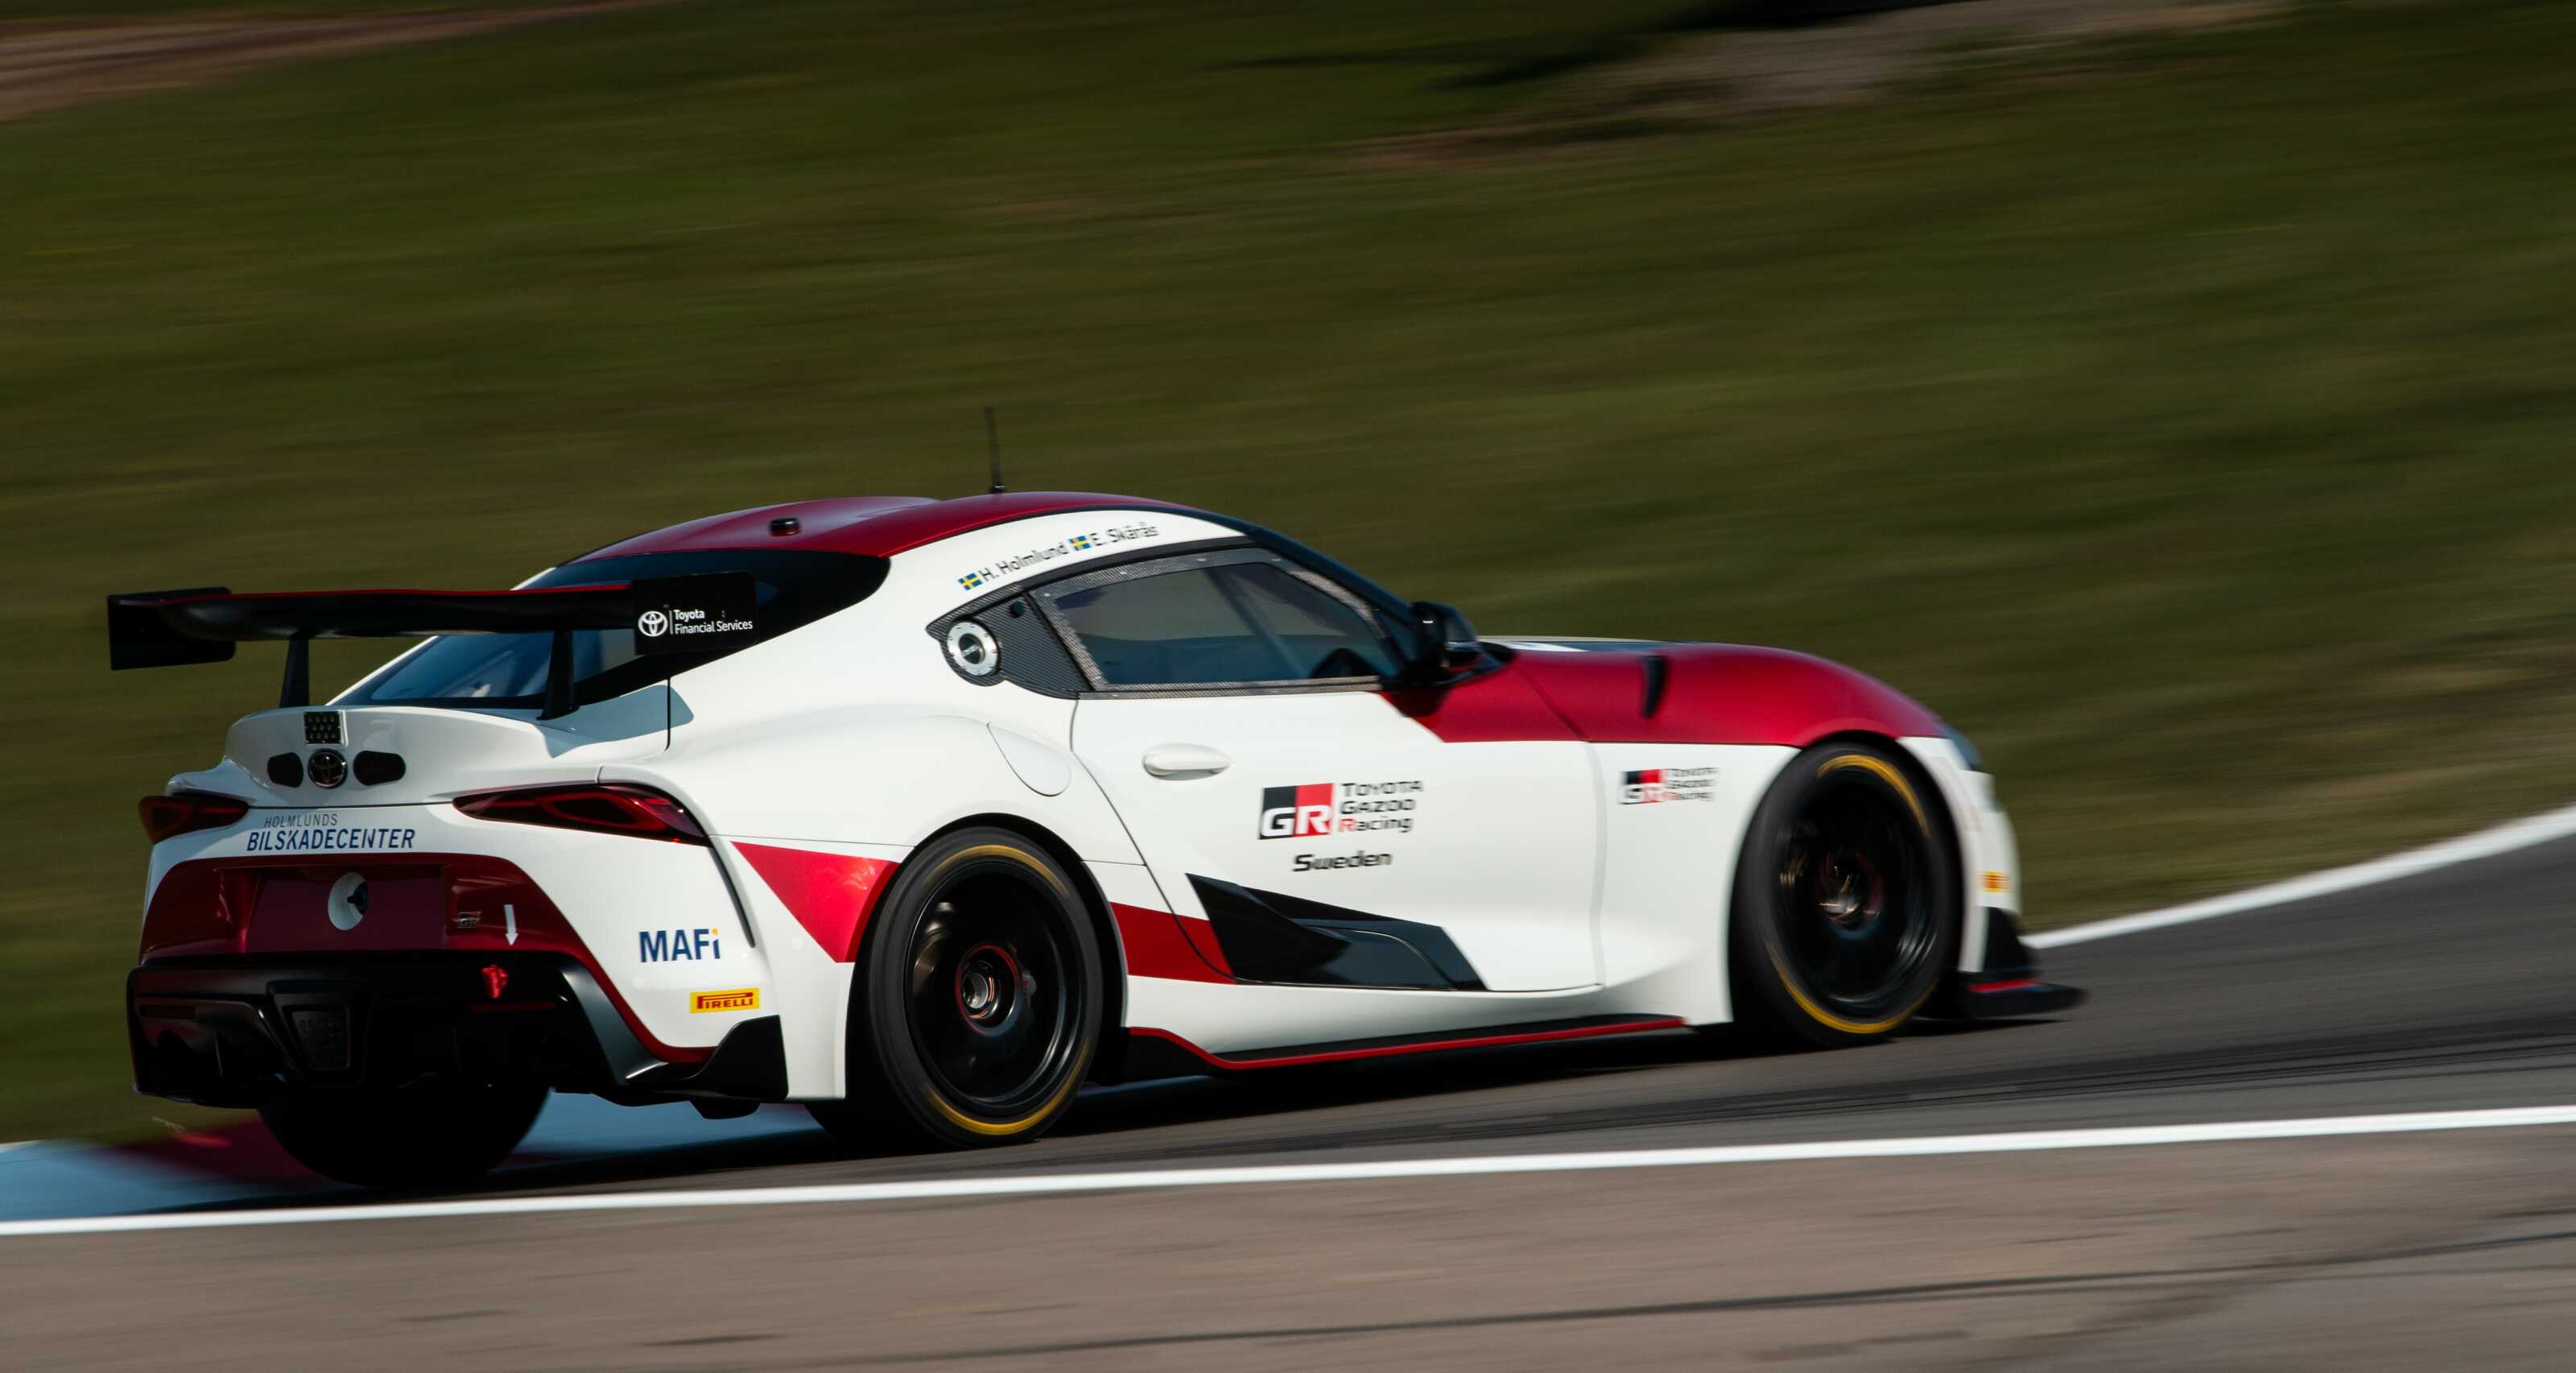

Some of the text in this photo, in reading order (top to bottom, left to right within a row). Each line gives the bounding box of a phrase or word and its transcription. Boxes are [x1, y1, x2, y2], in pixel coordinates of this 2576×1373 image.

[997, 542, 1069, 573] Holmlund
[673, 609, 705, 622] Toyota
[675, 619, 753, 635] Financial Services
[1342, 780, 1423, 797] TOYOTA
[1340, 799, 1417, 814] GAZOO
[264, 813, 339, 829] HOLMLUNDS
[1261, 804, 1331, 837] GR
[1339, 816, 1413, 833] Racing
[247, 829, 415, 851] BILSKADECENTER
[1292, 850, 1393, 871] Sweden
[696, 992, 753, 1009] PIRELLI
